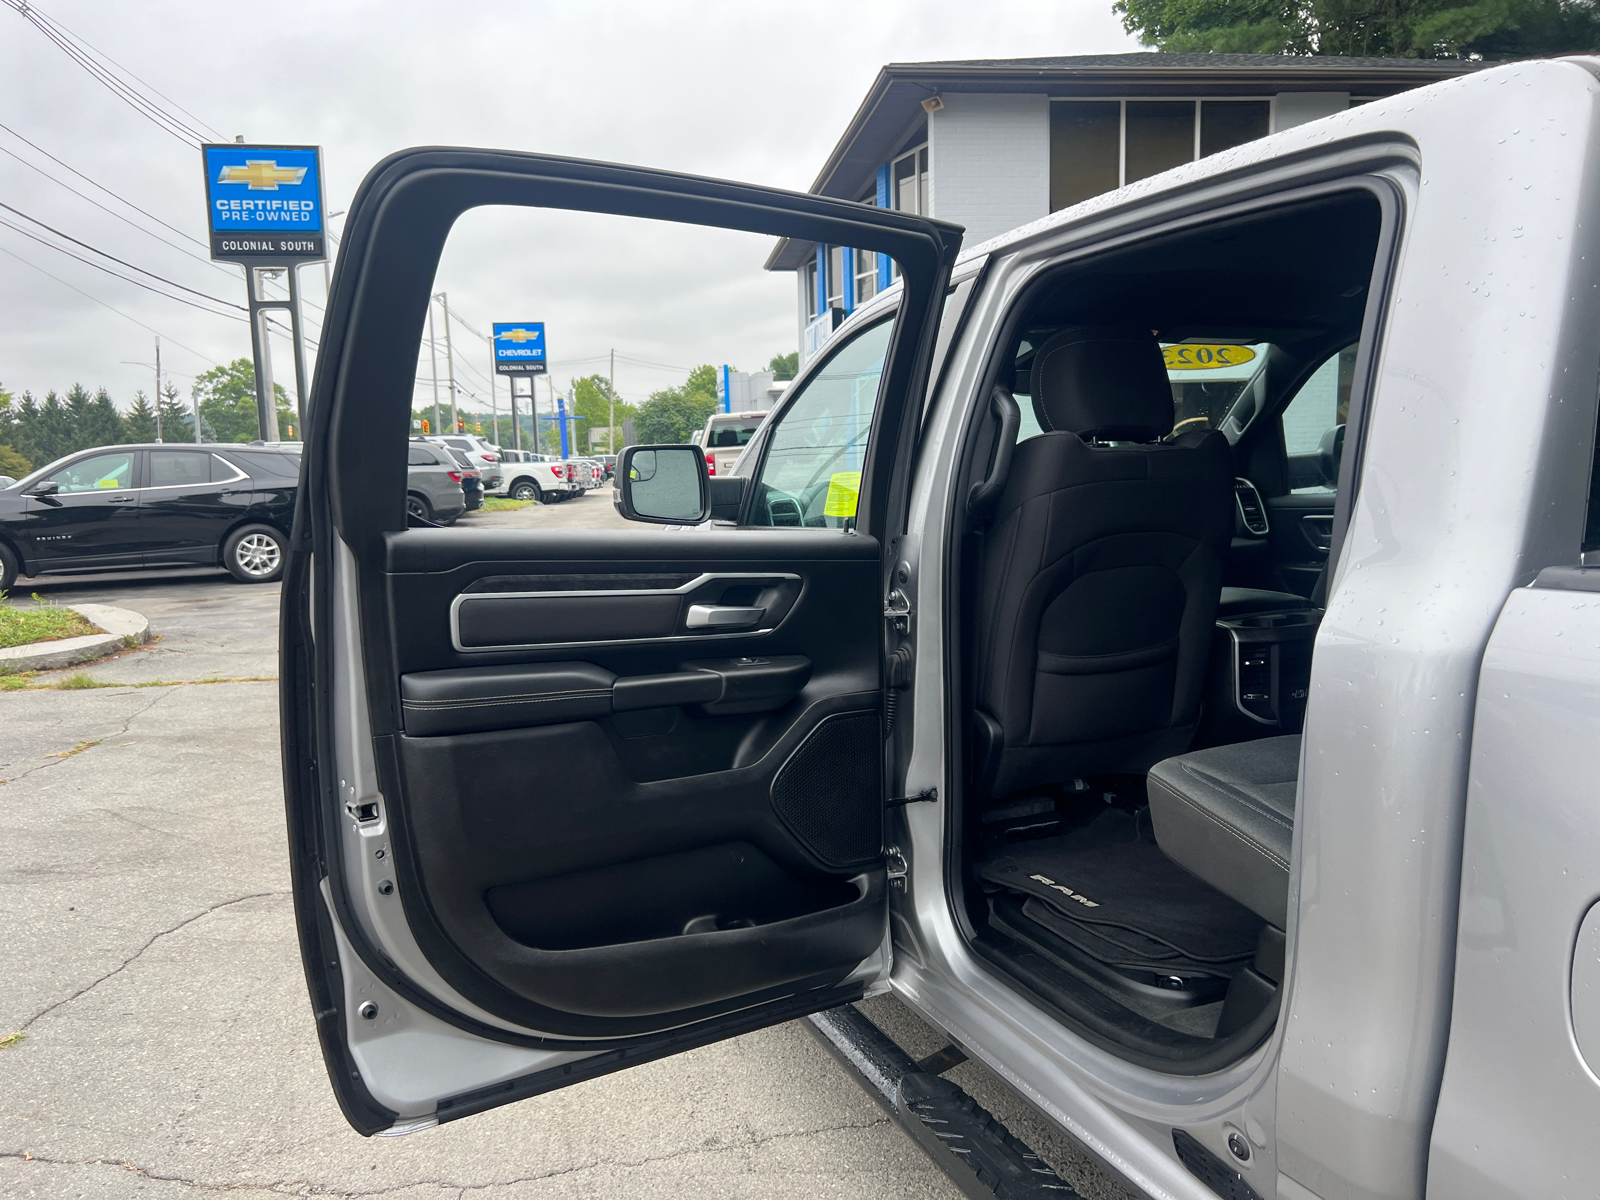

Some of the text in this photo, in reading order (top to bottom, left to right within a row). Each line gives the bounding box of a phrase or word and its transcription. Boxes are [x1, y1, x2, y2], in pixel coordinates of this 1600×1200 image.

[216, 199, 314, 211] CERTIFIED
[222, 211, 310, 222] PRE-OWNED
[222, 240, 315, 251] COLONIAL SOUTH
[498, 349, 543, 357] CHEVROLET
[1029, 873, 1100, 908] RAM
